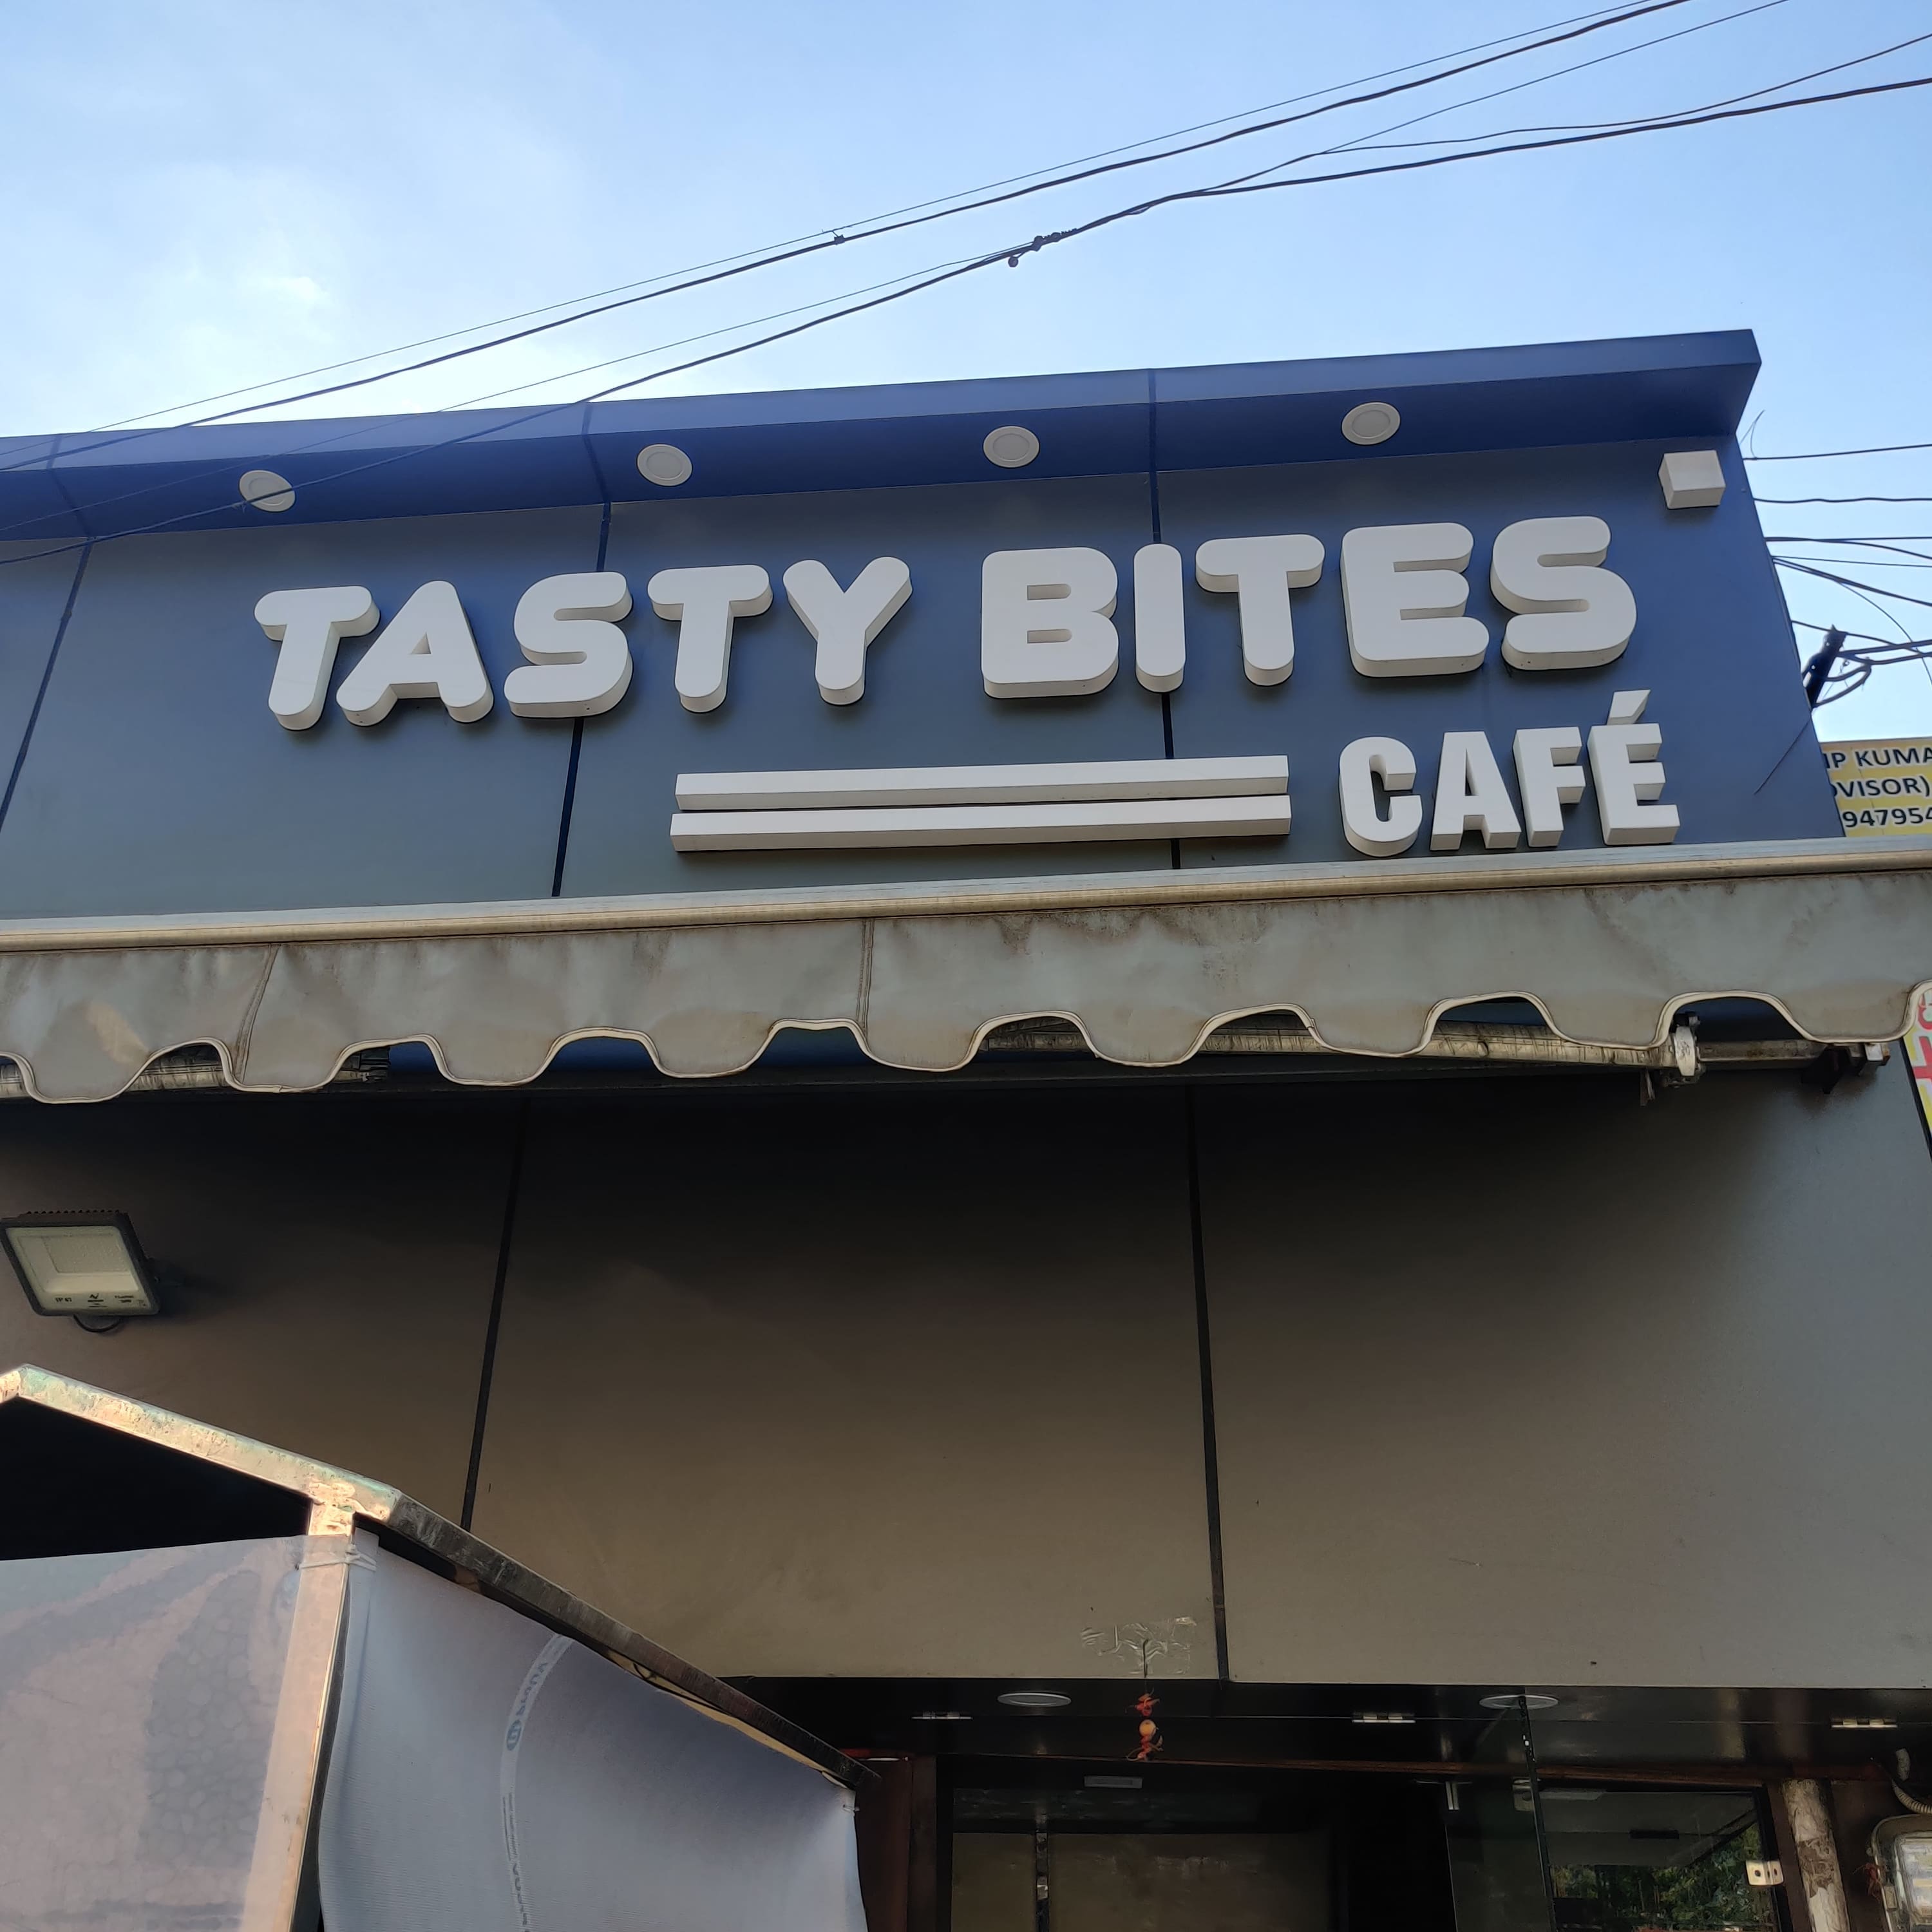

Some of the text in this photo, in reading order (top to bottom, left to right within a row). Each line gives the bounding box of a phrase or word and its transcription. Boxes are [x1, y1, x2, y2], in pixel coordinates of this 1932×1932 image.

[254, 516, 1637, 730] TASTY BITES
[1338, 689, 1680, 857] CAFÉ
[1831, 775, 1930, 797] VISOR)
